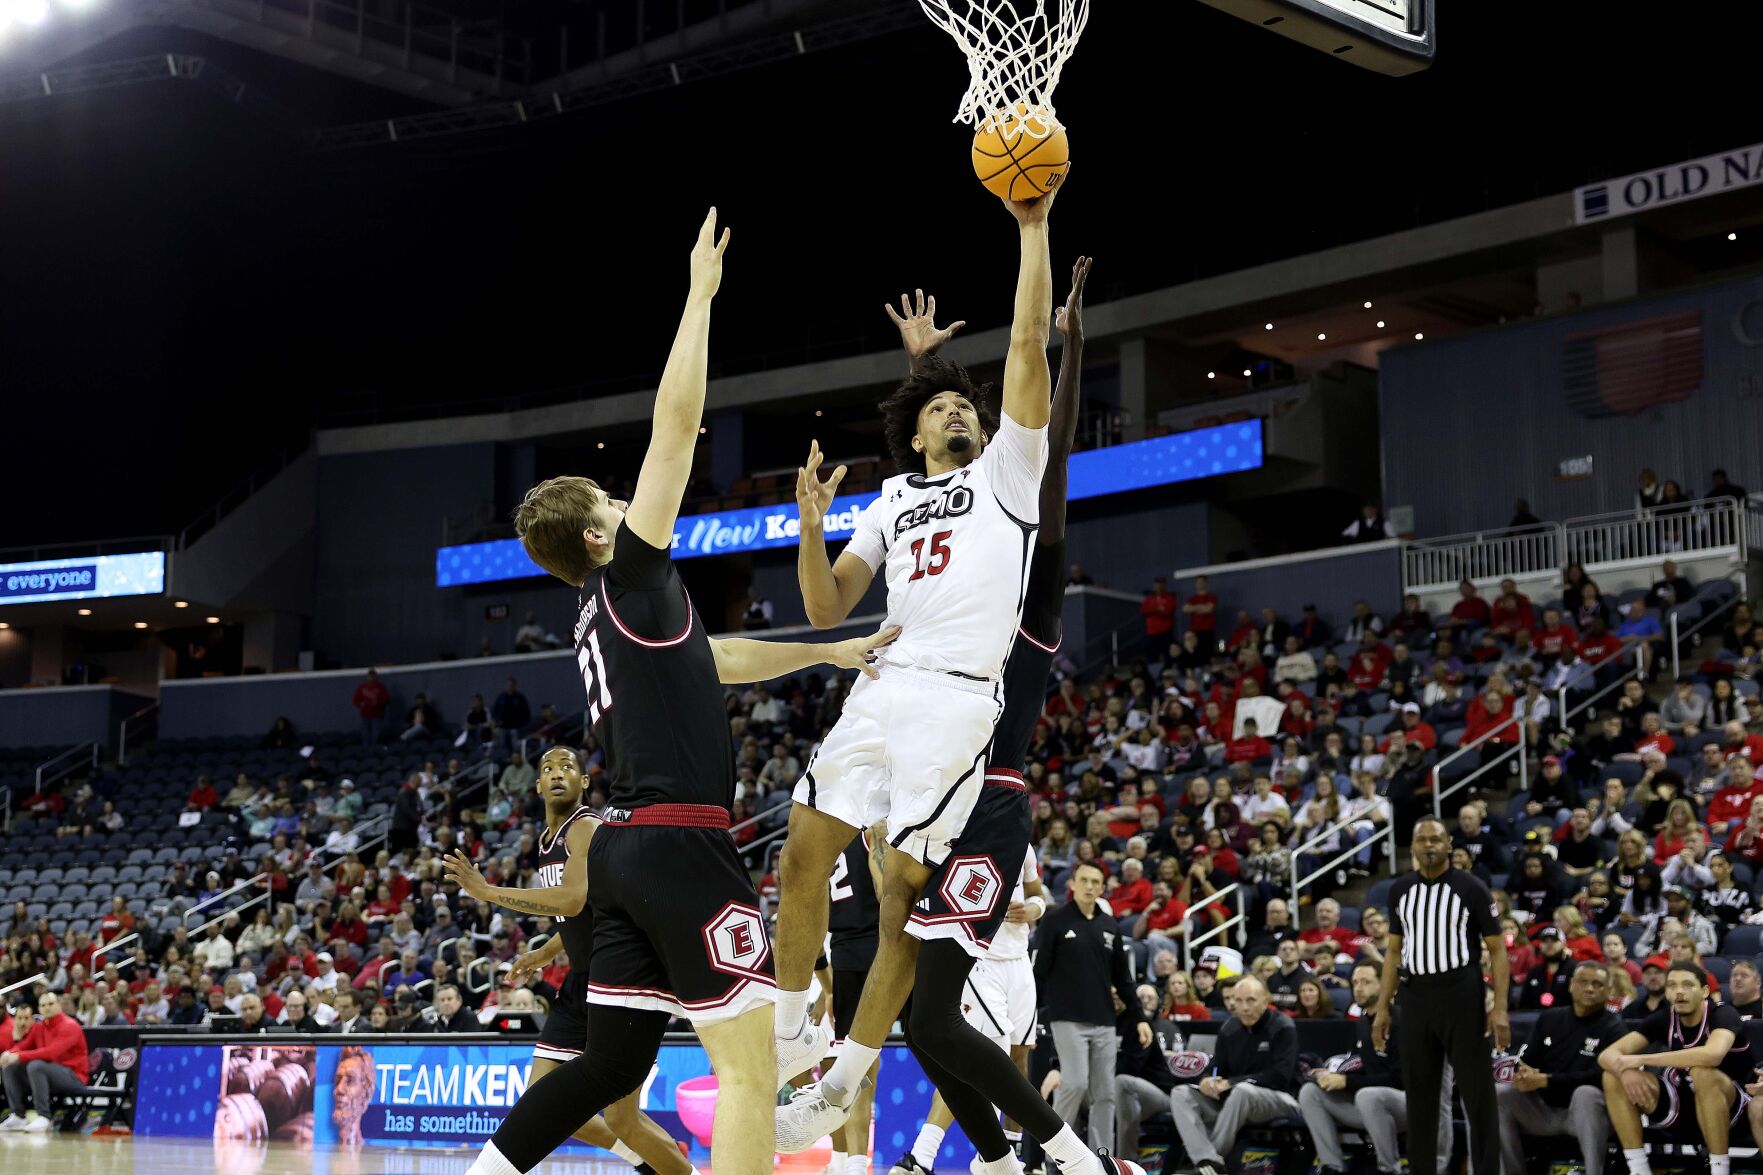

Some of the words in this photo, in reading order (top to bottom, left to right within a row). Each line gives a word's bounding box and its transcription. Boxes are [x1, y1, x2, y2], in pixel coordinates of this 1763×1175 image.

[1624, 163, 1709, 208] OLD
[893, 485, 974, 542] SEMO
[688, 517, 760, 554] New
[908, 529, 953, 583] 15
[7, 570, 92, 591] everyone
[577, 627, 613, 726] 21
[958, 868, 990, 905] E
[724, 920, 755, 959] E
[383, 1109, 415, 1132] has
[420, 1110, 505, 1134] somethin
